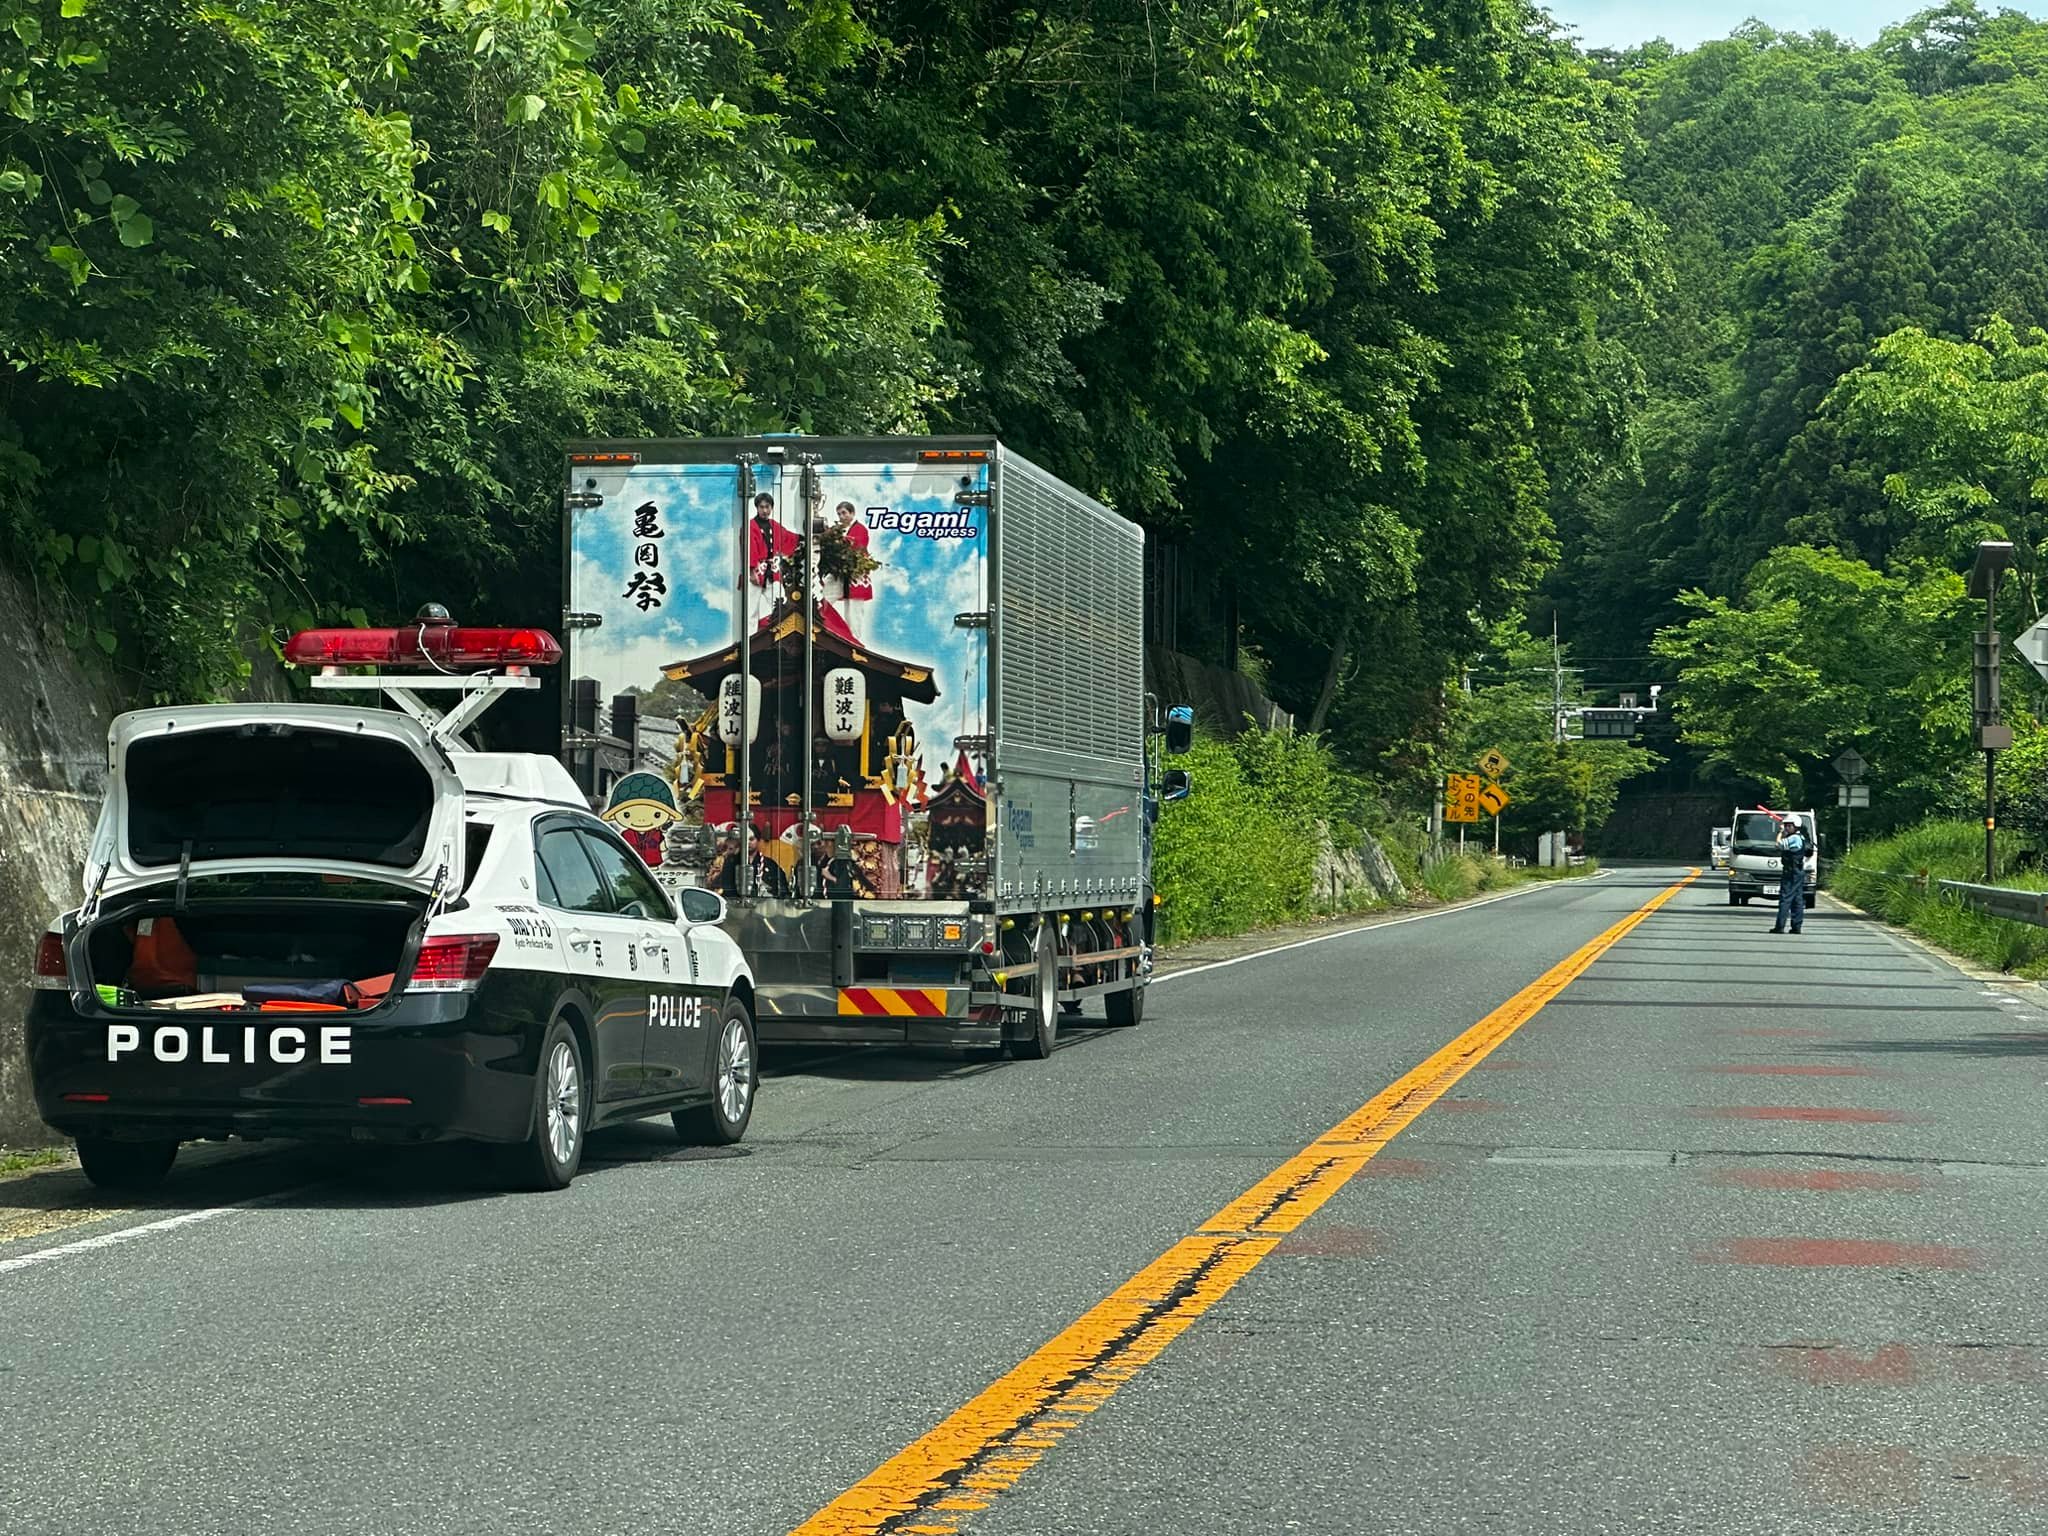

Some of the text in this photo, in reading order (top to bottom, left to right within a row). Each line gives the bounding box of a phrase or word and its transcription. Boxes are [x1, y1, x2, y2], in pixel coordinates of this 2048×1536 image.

[866, 507, 970, 534] Tagami
[917, 526, 977, 540] express
[622, 500, 667, 612] 亀岡祭
[724, 680, 742, 736] 難波山
[834, 677, 855, 732] 難波山
[1464, 779, 1476, 817] この先
[506, 918, 530, 936] DIAL
[649, 994, 702, 1028] POLICE
[107, 1024, 353, 1065] POLICE
